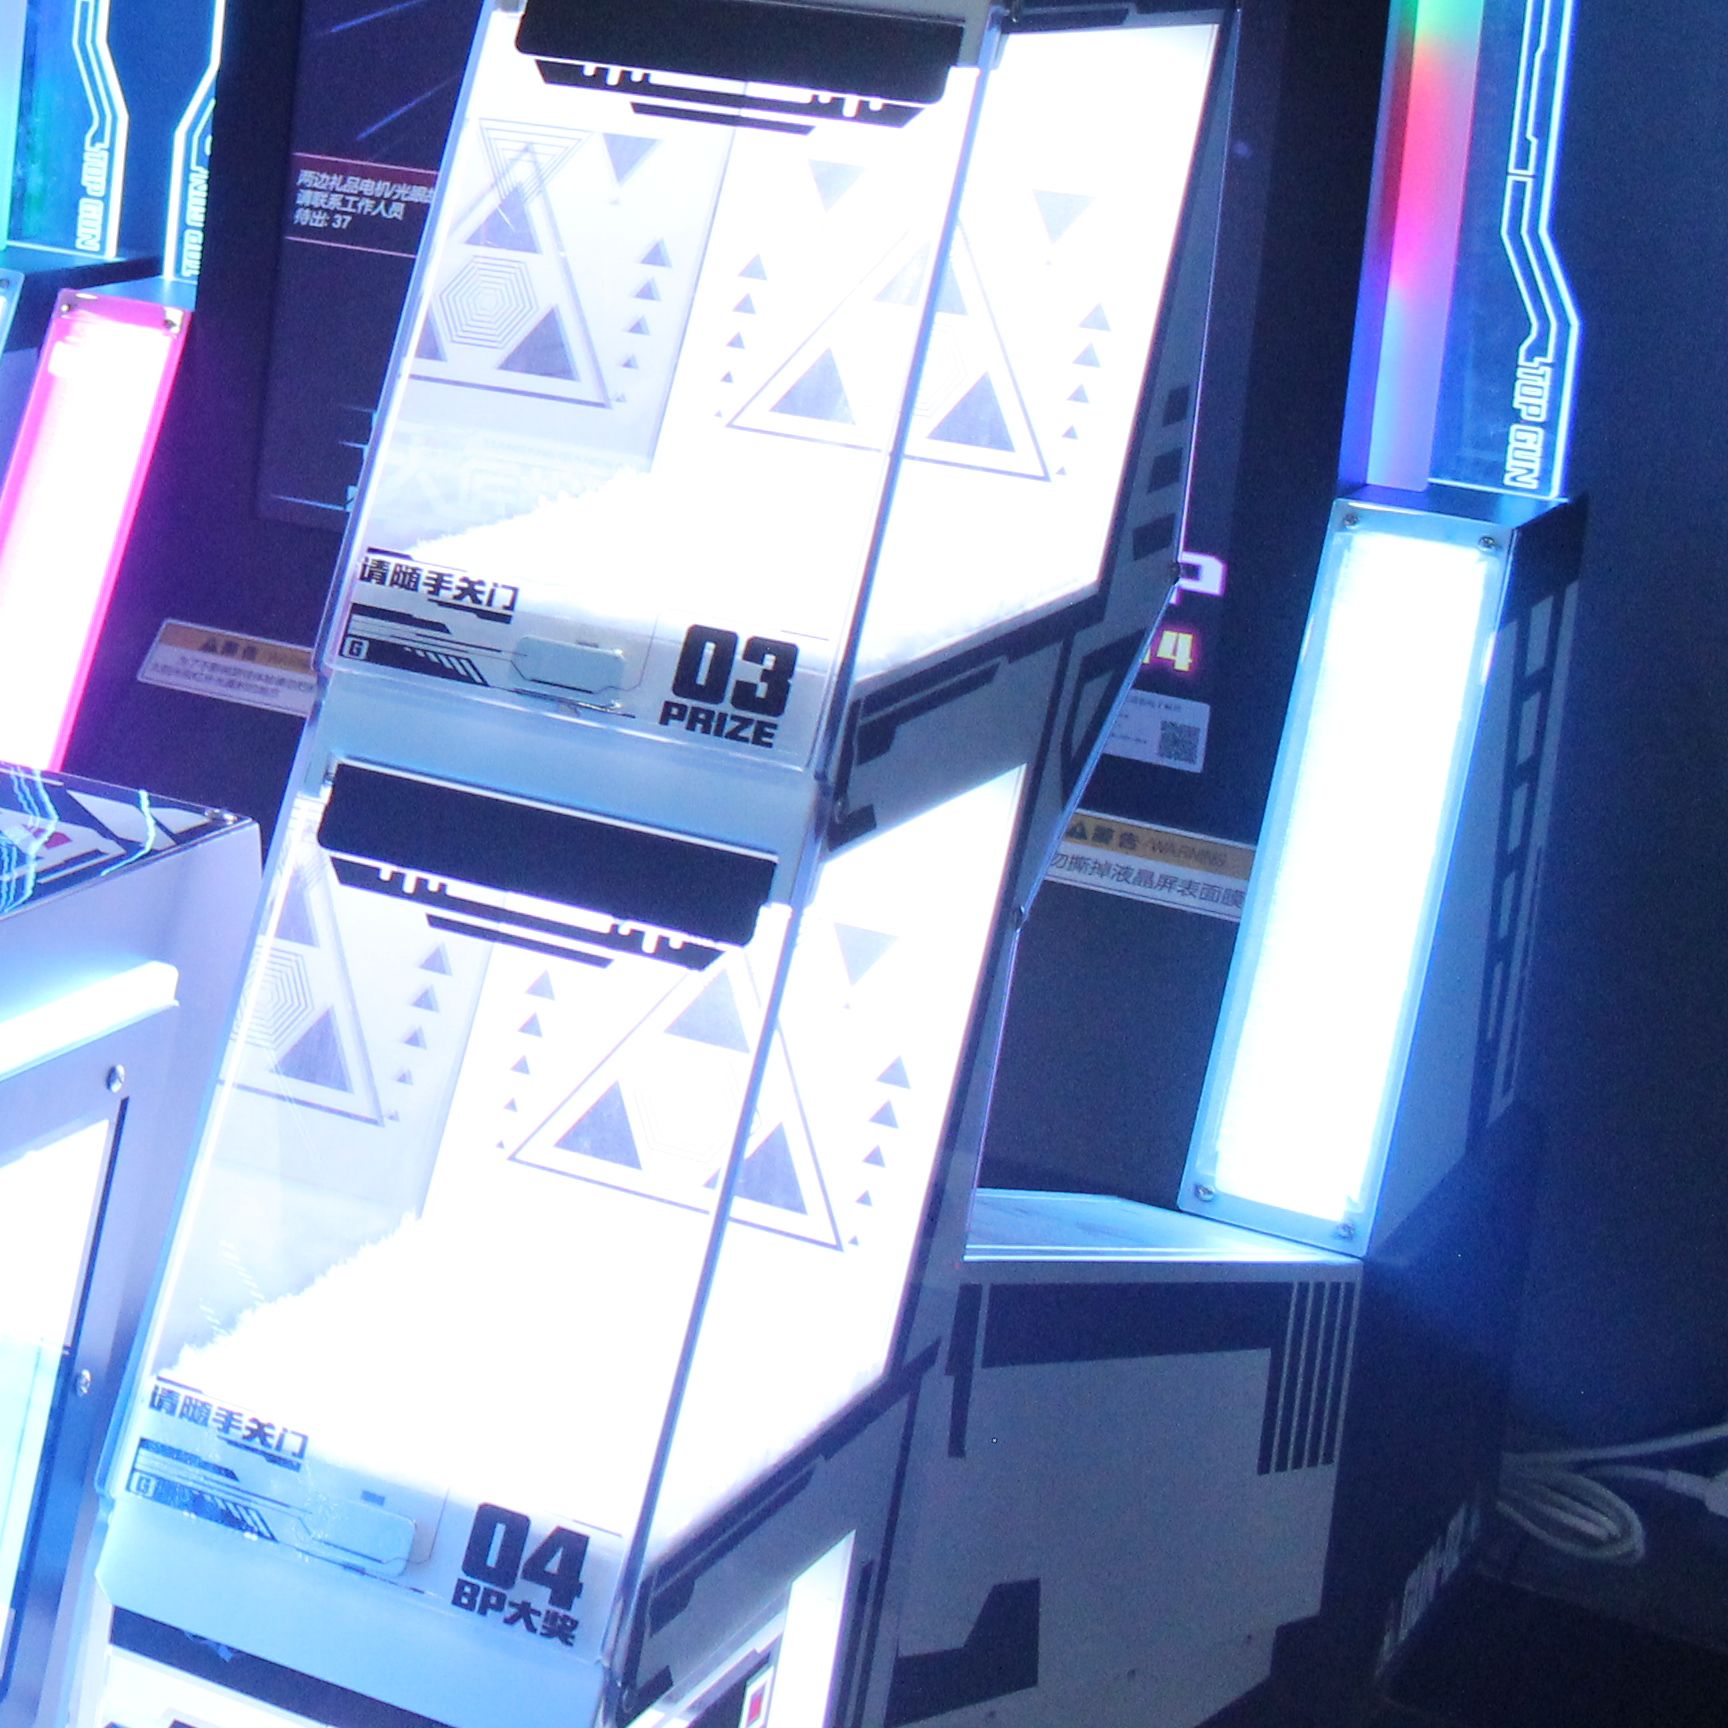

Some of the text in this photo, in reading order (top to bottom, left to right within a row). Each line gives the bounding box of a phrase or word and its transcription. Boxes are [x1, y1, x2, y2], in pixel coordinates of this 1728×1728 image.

[75, 151, 109, 251] TOP GUN
[331, 213, 352, 229] 37
[1503, 363, 1552, 489] TOP GUN
[359, 557, 520, 612] 请随手关门
[672, 624, 799, 718] 03
[658, 701, 778, 748] PRIZE
[148, 1385, 308, 1459] 请随手关门
[461, 1502, 591, 1612] 04
[450, 1578, 579, 1647] BP大奖
